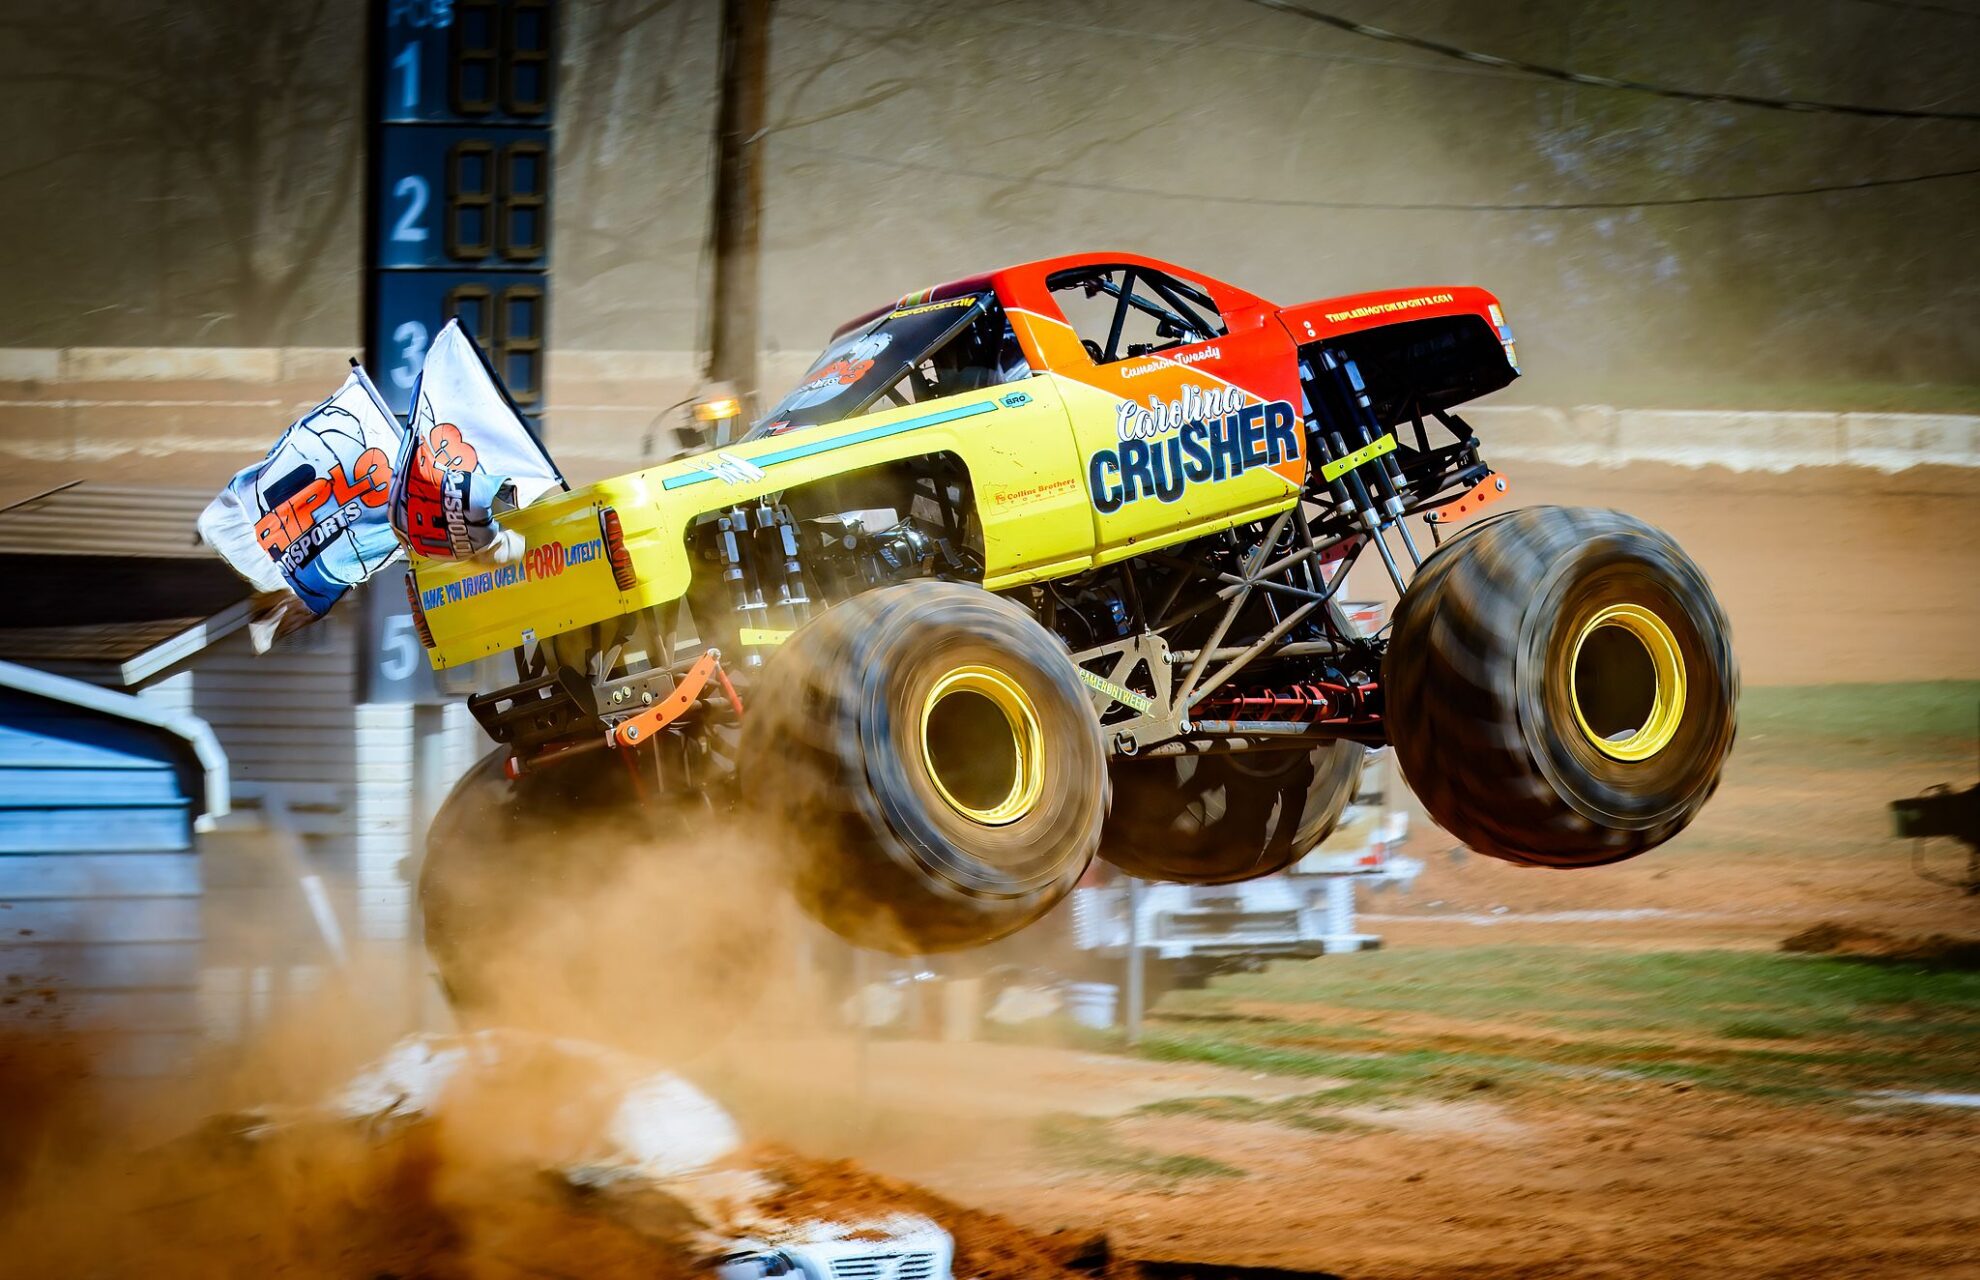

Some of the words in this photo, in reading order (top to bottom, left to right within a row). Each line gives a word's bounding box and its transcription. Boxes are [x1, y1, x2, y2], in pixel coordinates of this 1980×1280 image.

[392, 41, 421, 107] 1
[391, 175, 430, 242] 2
[390, 319, 428, 389] 3
[1121, 357, 1177, 379] Cameron
[1174, 346, 1221, 366] Tweedy
[1005, 394, 1026, 407] BRO
[1116, 383, 1246, 442] Carolina
[1007, 488, 1037, 500] Collins
[1038, 478, 1076, 492] Brothers
[1089, 400, 1301, 516] CRUSHER
[422, 584, 446, 611] HAVE
[445, 581, 463, 604] YOU
[462, 571, 494, 600] DRIVEN
[494, 563, 517, 589] OVER
[525, 541, 565, 583] FORD
[380, 613, 420, 681] 5
